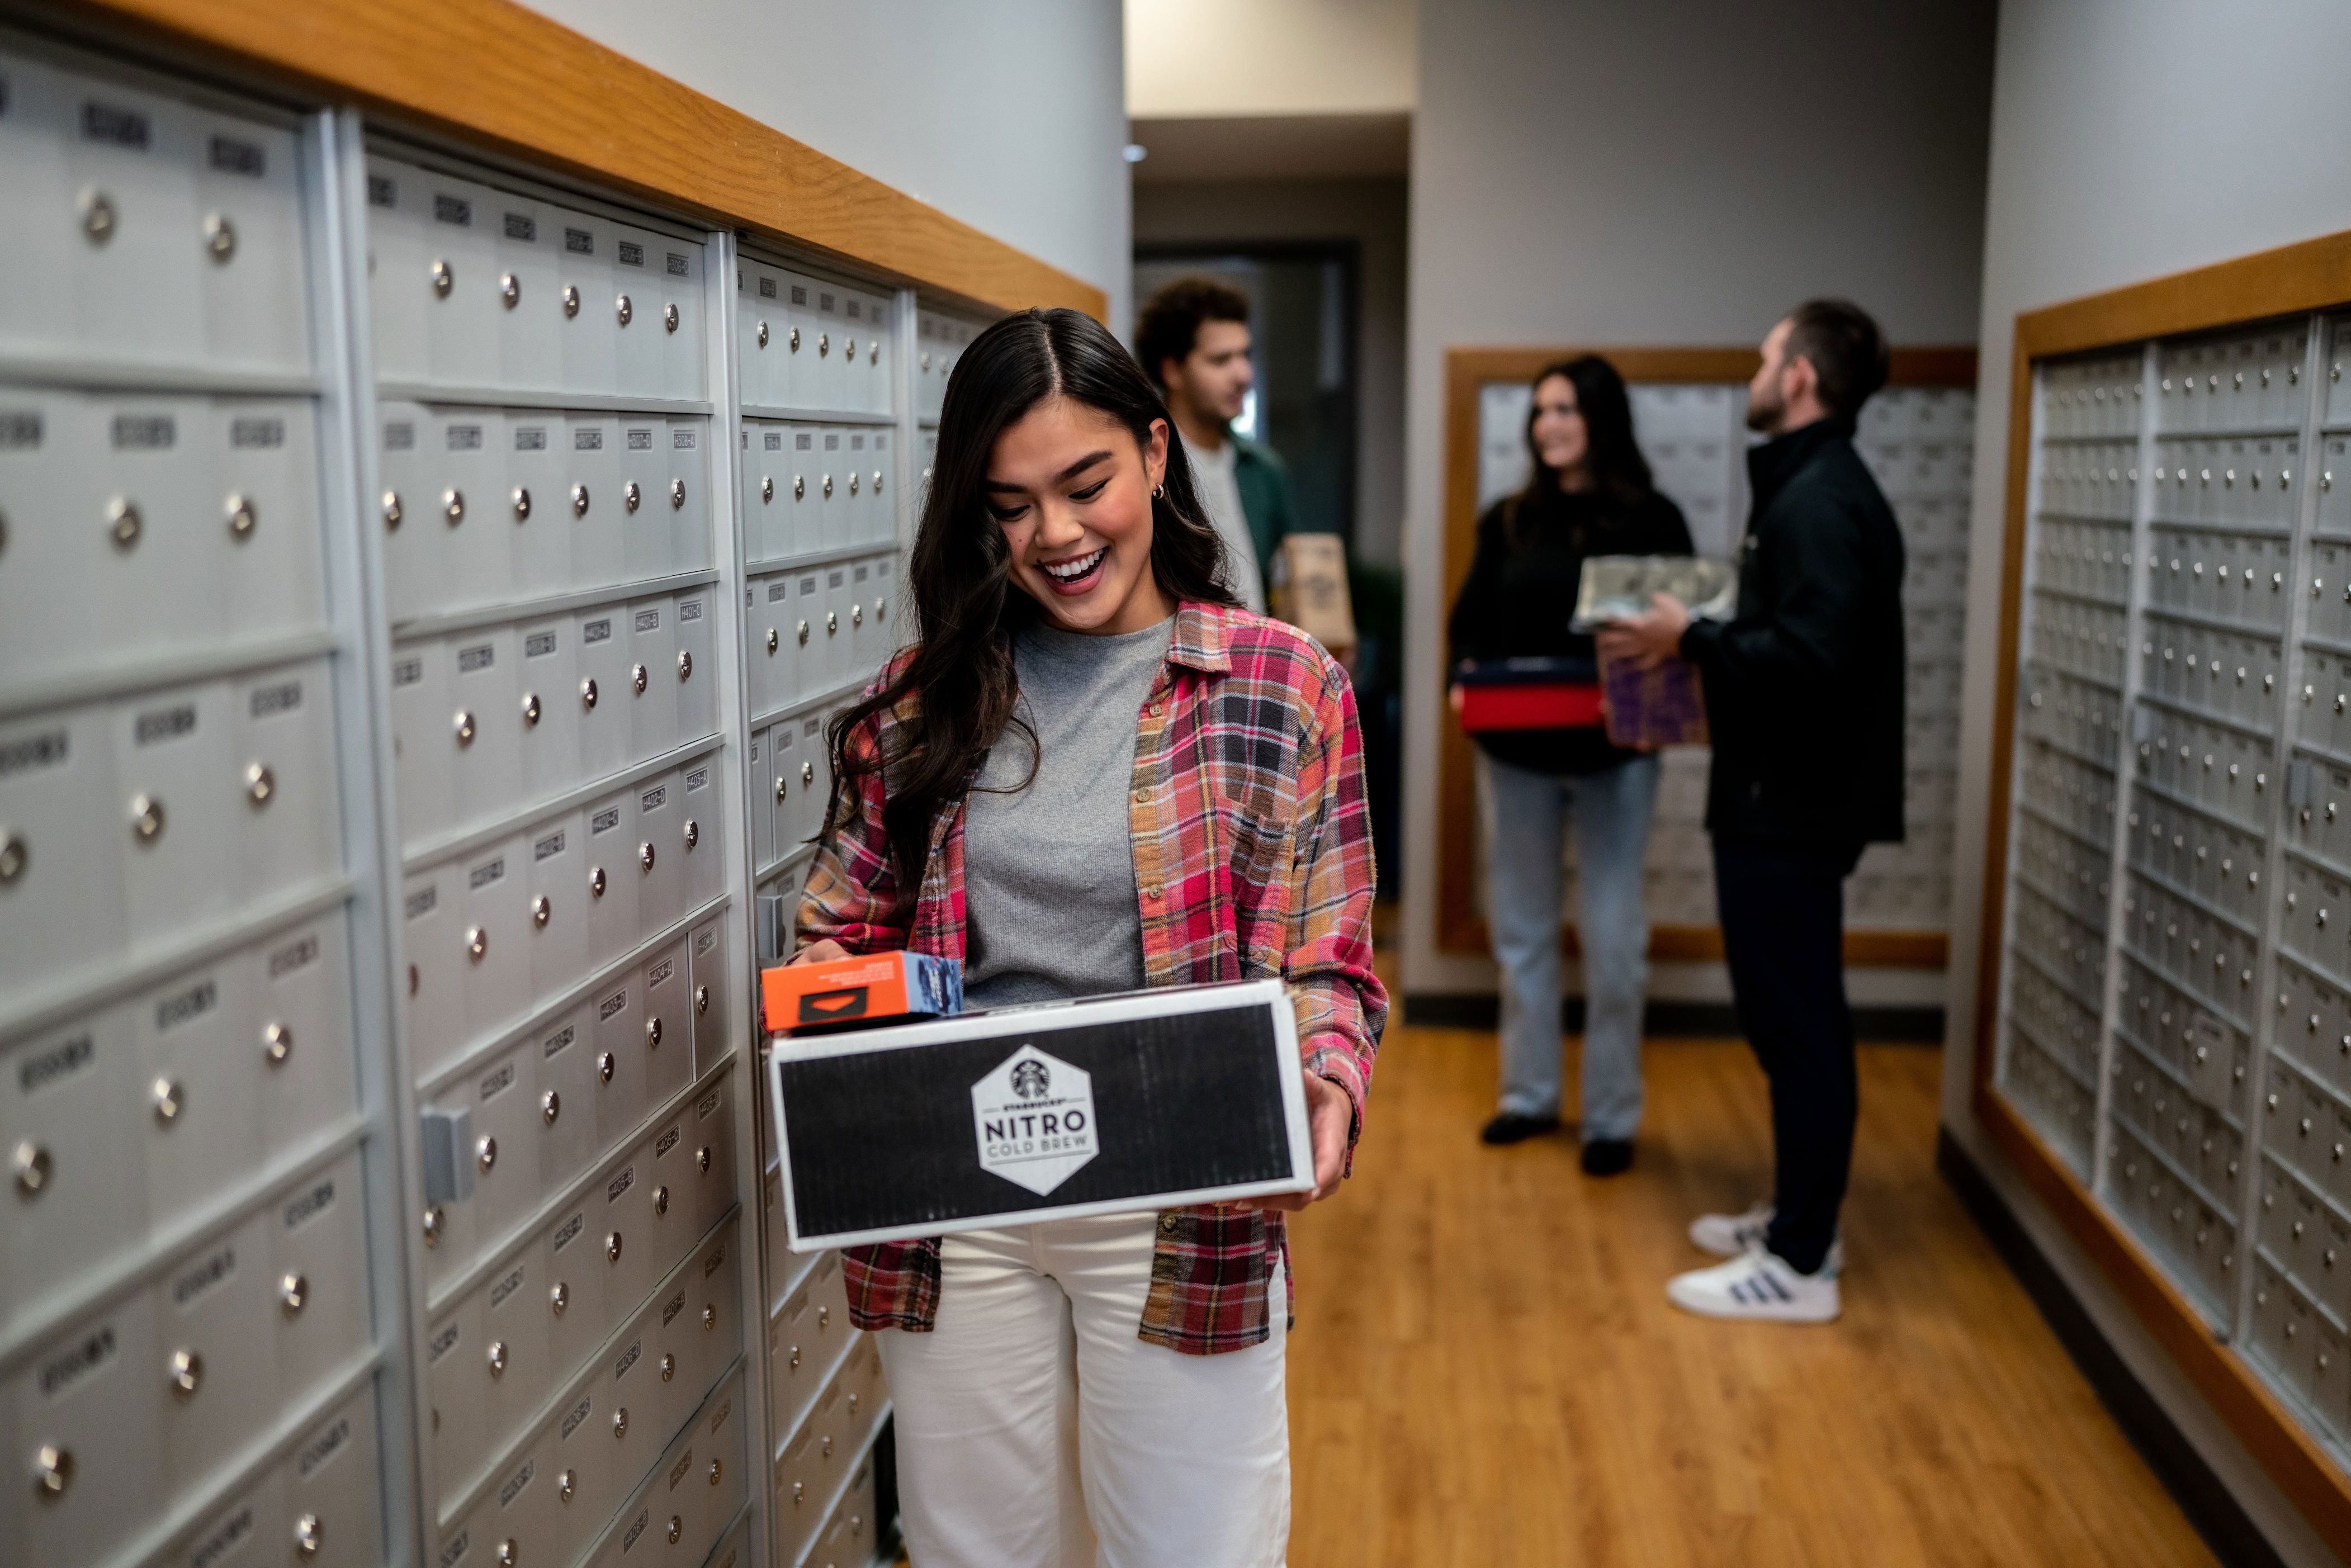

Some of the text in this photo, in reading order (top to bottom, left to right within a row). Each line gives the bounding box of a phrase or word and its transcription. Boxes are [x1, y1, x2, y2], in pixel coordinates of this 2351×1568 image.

[668, 259, 688, 273] H306-C
[674, 435, 694, 447] H308-A
[682, 605, 700, 619] H401-C
[687, 774, 707, 789] H403-A
[643, 790, 665, 809] H402-D
[698, 931, 715, 951] H404-B
[650, 962, 671, 984] H404-A
[699, 1093, 718, 1117] H405-D
[985, 1110, 1085, 1142] NITRO
[657, 1129, 678, 1155] H405-C
[987, 1134, 1087, 1158] COLD BREW
[609, 1171, 633, 1197] H405-B
[664, 1295, 685, 1323] H407-A
[616, 1344, 640, 1374] H406-D
[625, 1513, 647, 1547] H408-B
